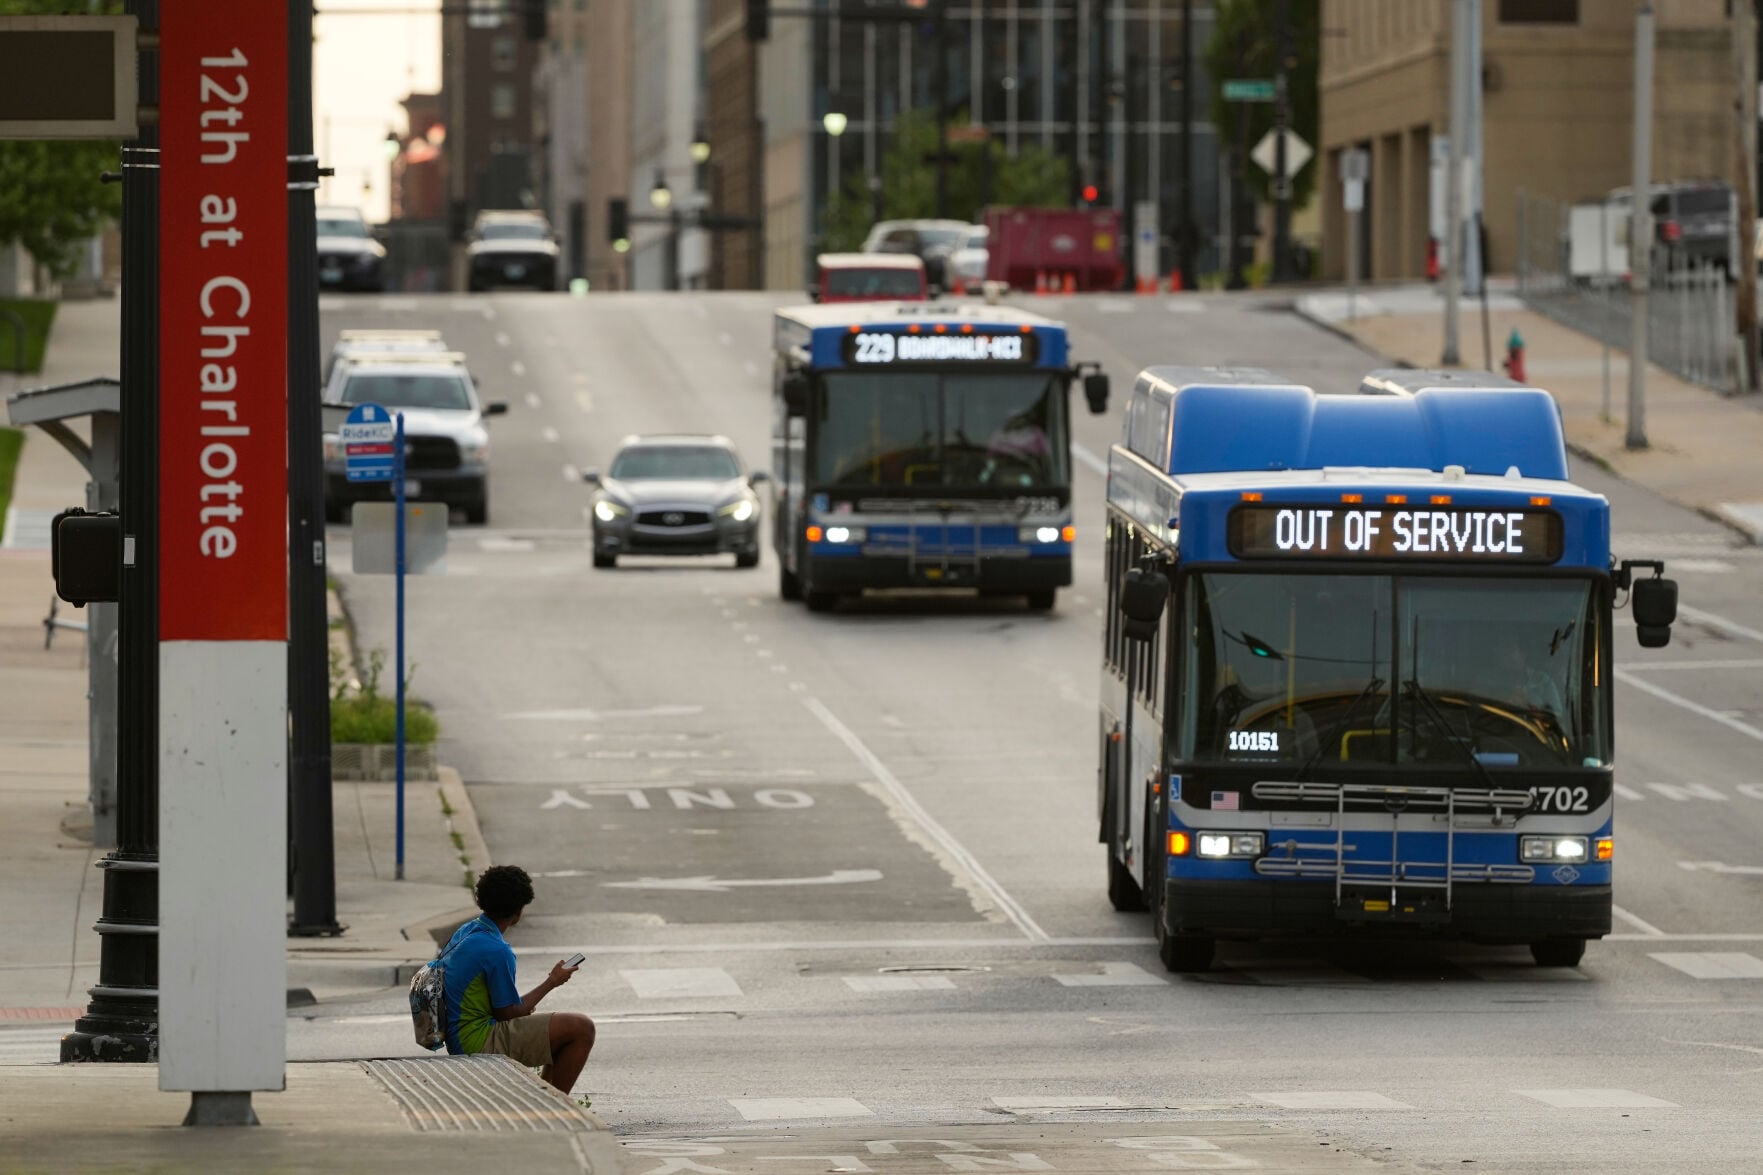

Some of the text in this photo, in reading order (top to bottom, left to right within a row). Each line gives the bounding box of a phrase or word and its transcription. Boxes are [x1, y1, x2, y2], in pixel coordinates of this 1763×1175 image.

[199, 47, 251, 558] 12th at Charlotte
[855, 333, 895, 363] 229
[1276, 510, 1524, 553] OUT OF SERVICE
[1229, 731, 1279, 751] 10151
[540, 788, 815, 809] ONLY
